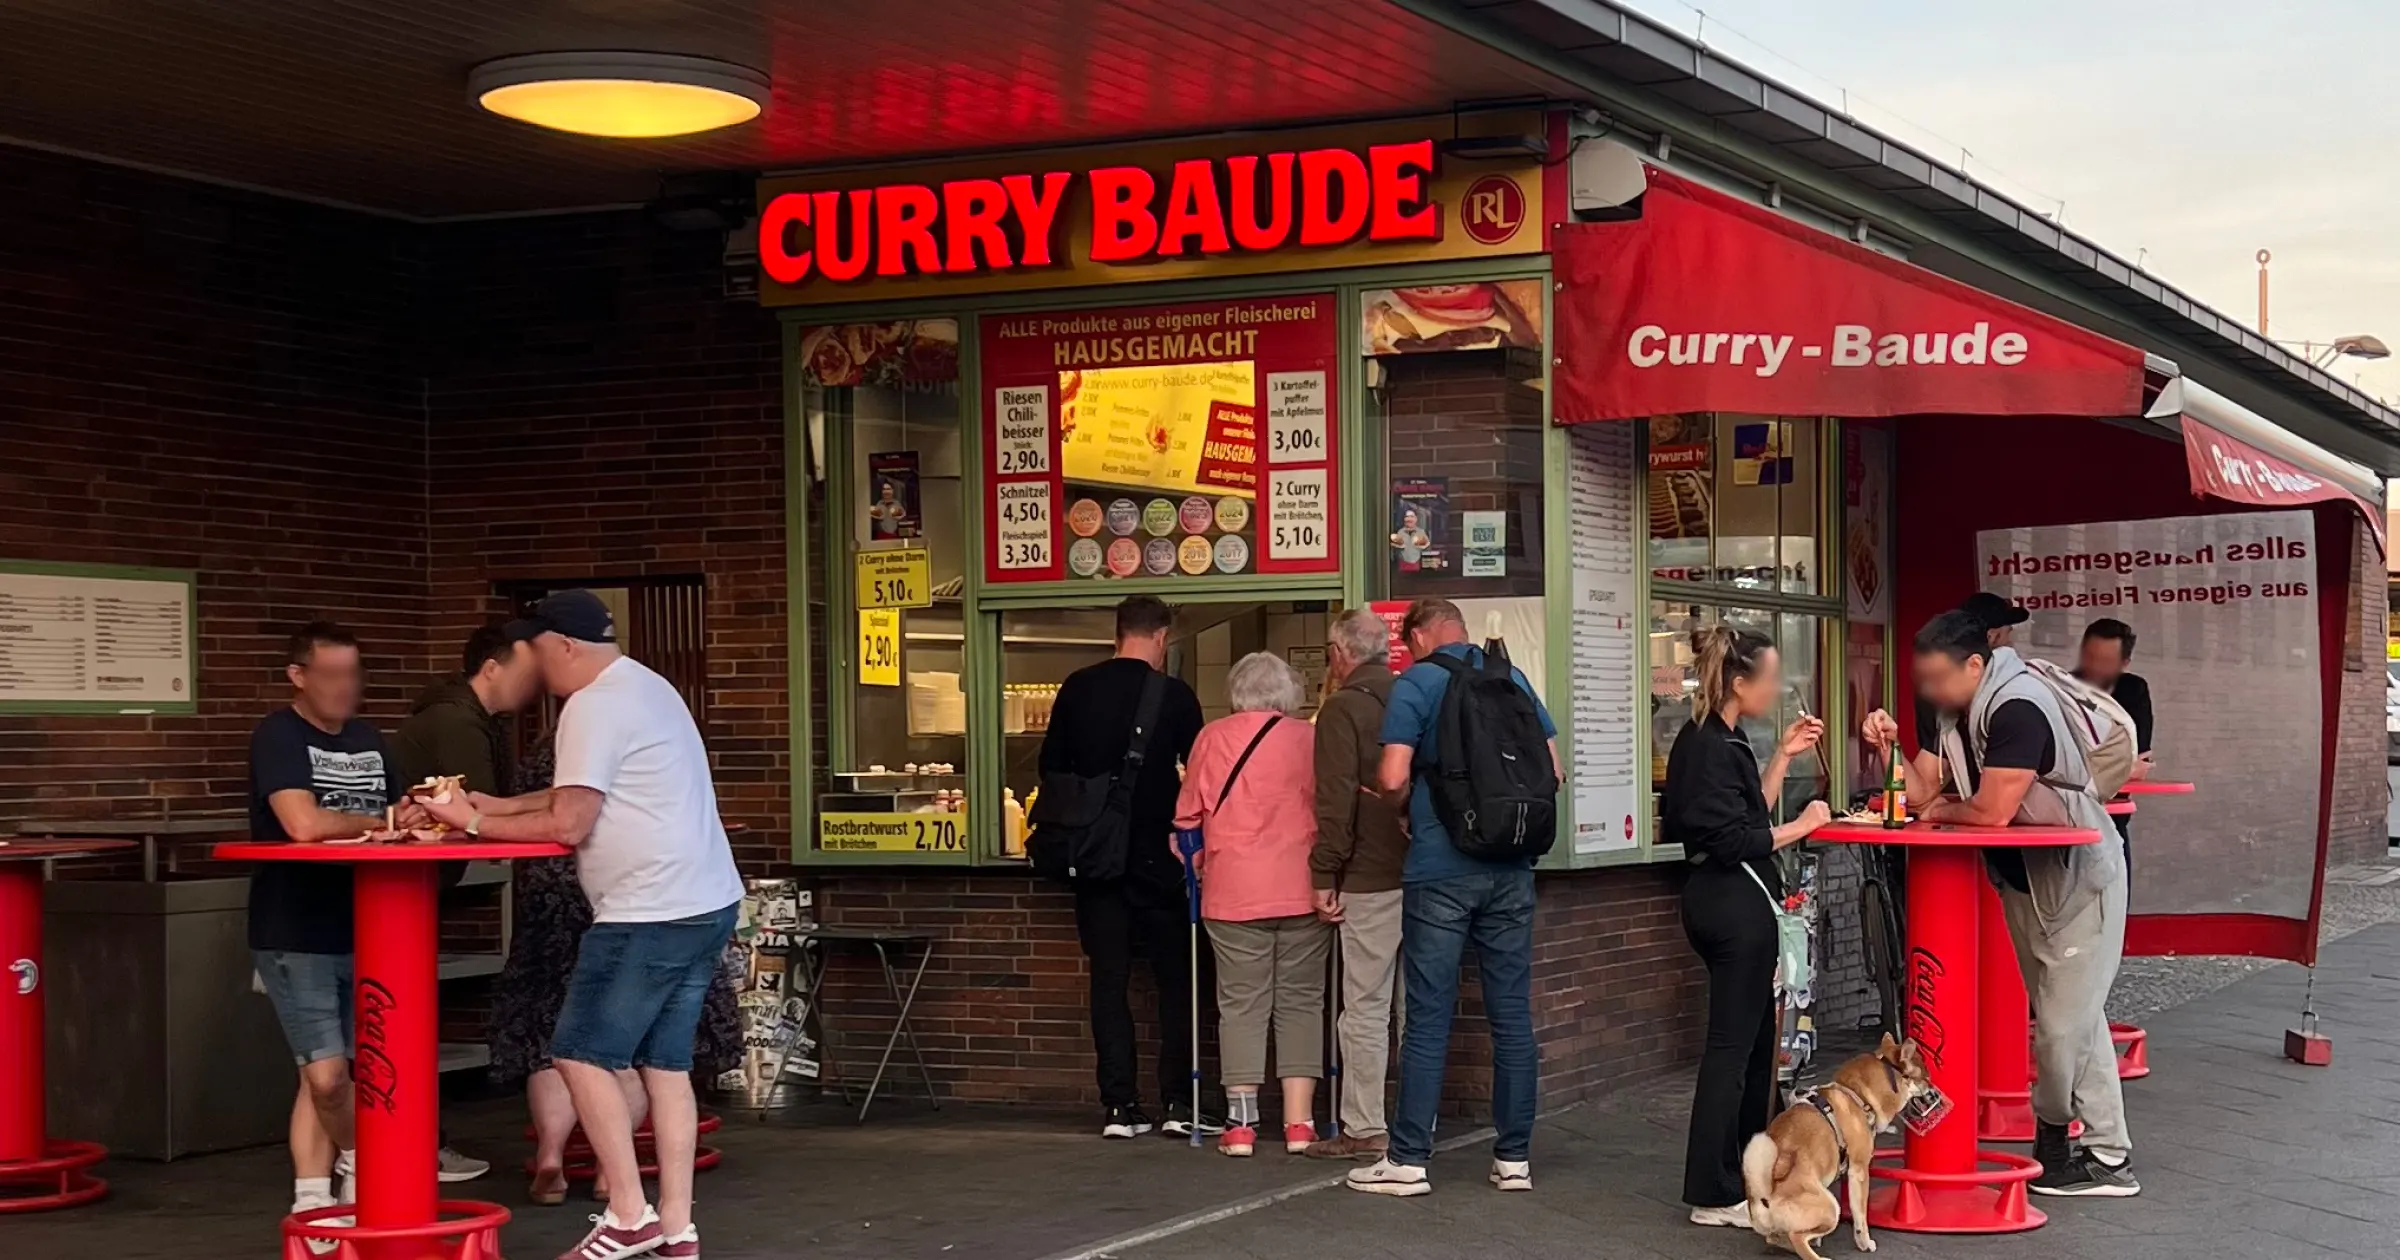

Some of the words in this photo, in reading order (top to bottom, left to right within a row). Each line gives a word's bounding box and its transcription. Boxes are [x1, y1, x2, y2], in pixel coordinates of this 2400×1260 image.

[759, 171, 1072, 284] CURRY
[1088, 139, 1441, 262] BAUDE
[1471, 188, 1518, 229] RL
[1000, 321, 1037, 339] ALLE
[1043, 316, 1118, 335] Produkte
[1123, 317, 1150, 332] aus
[1156, 311, 1219, 333] eigener
[1225, 302, 1317, 325] Fleischerei
[1054, 329, 1259, 366] HAUSGEMACHT
[1003, 390, 1043, 406] Riesen
[1007, 406, 1038, 422] Chili-
[1002, 424, 1044, 439] beisser
[1000, 484, 1049, 500] Schnitzel
[1275, 481, 1282, 496] 2
[1286, 481, 1321, 499] Curry
[823, 820, 908, 836] Rostbratwurst
